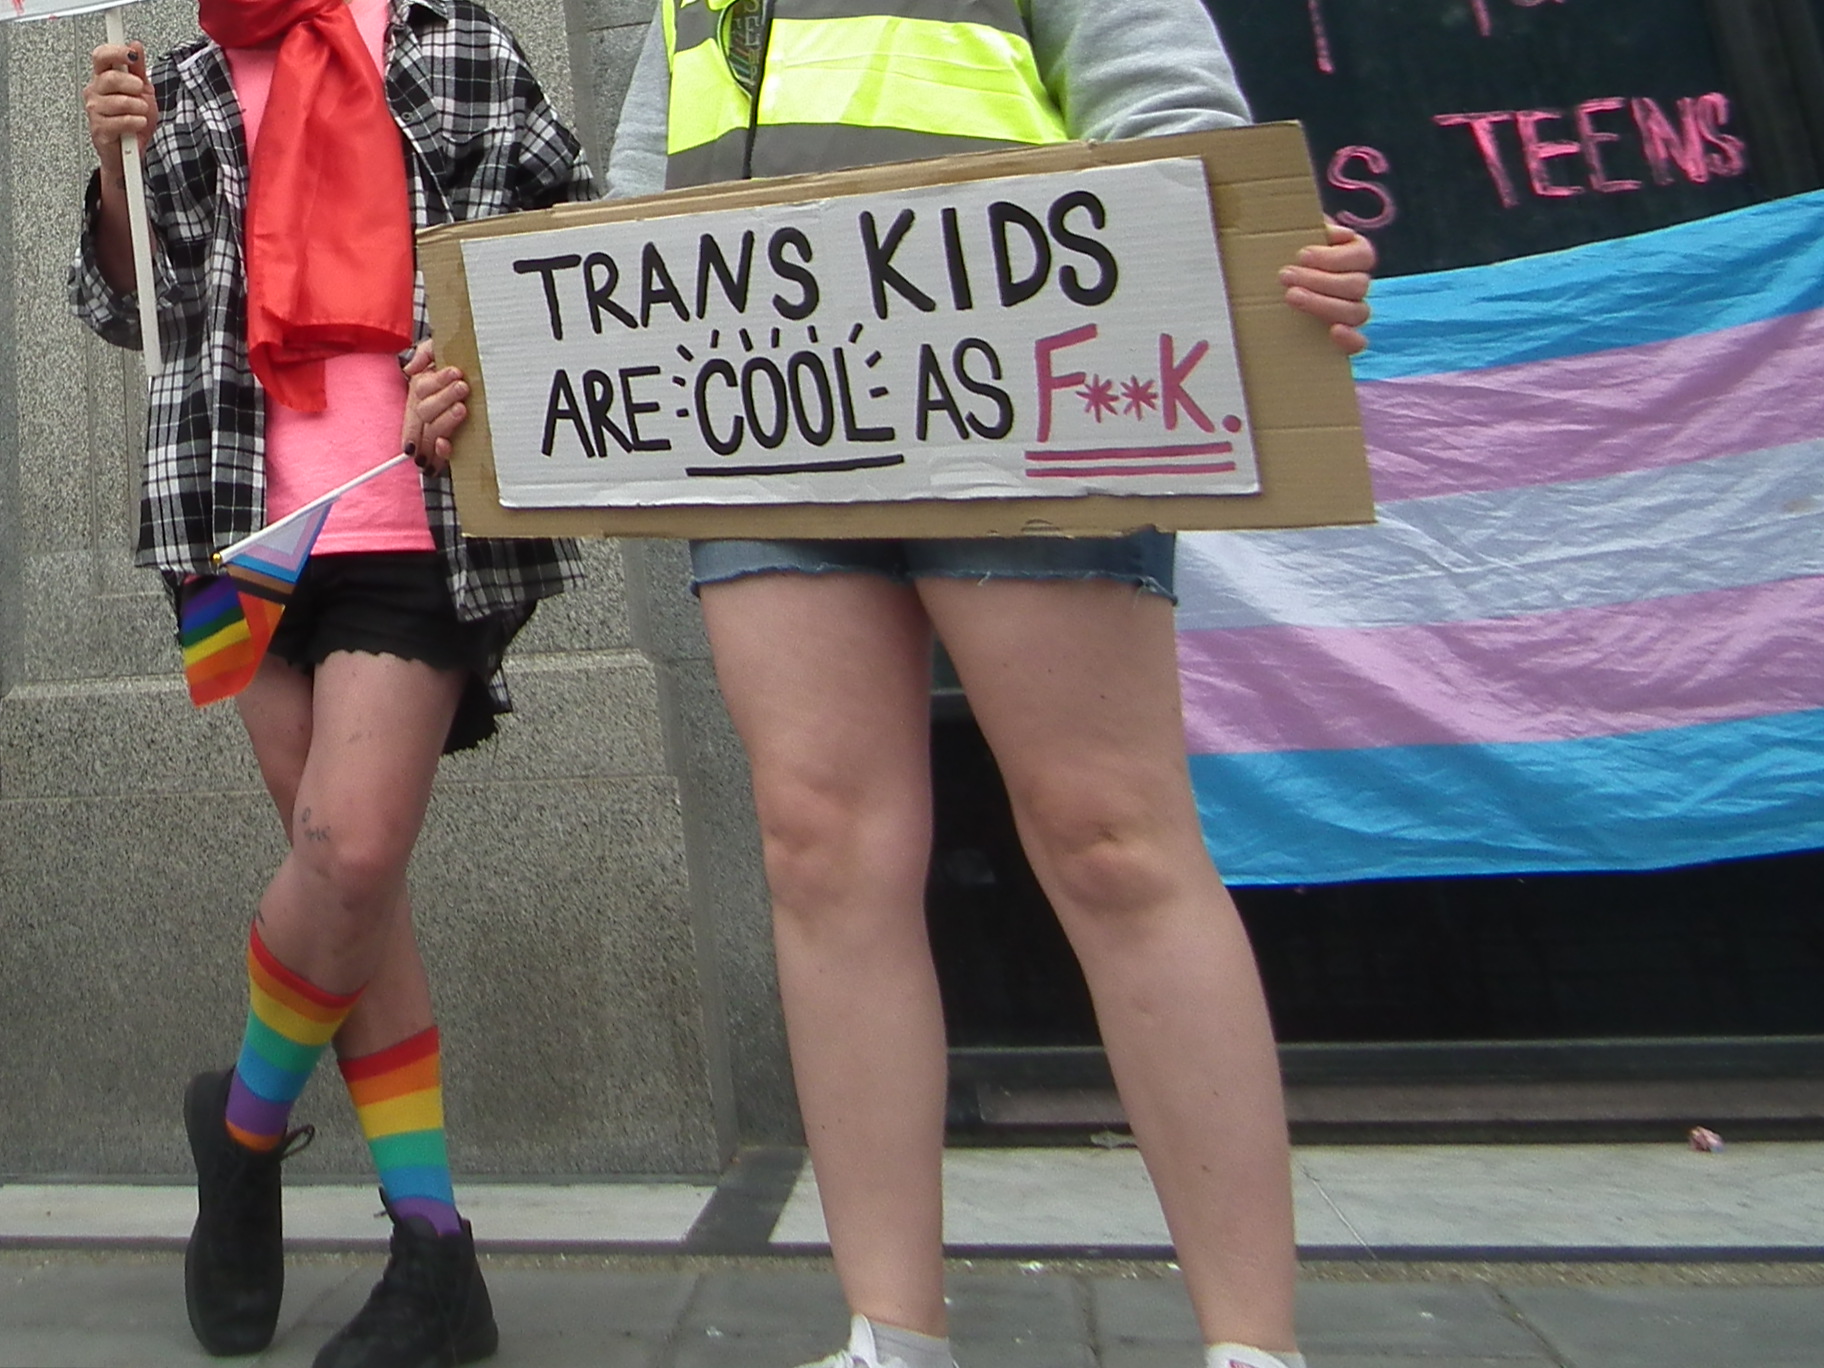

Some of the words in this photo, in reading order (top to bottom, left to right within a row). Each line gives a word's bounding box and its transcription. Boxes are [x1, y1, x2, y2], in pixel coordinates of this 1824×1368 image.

[1430, 92, 1746, 208] TEENS
[513, 226, 820, 341] TRANS
[860, 189, 1118, 321] KIDS
[541, 364, 671, 459] ARE
[693, 347, 895, 456] COOL
[915, 337, 1015, 442] AS
